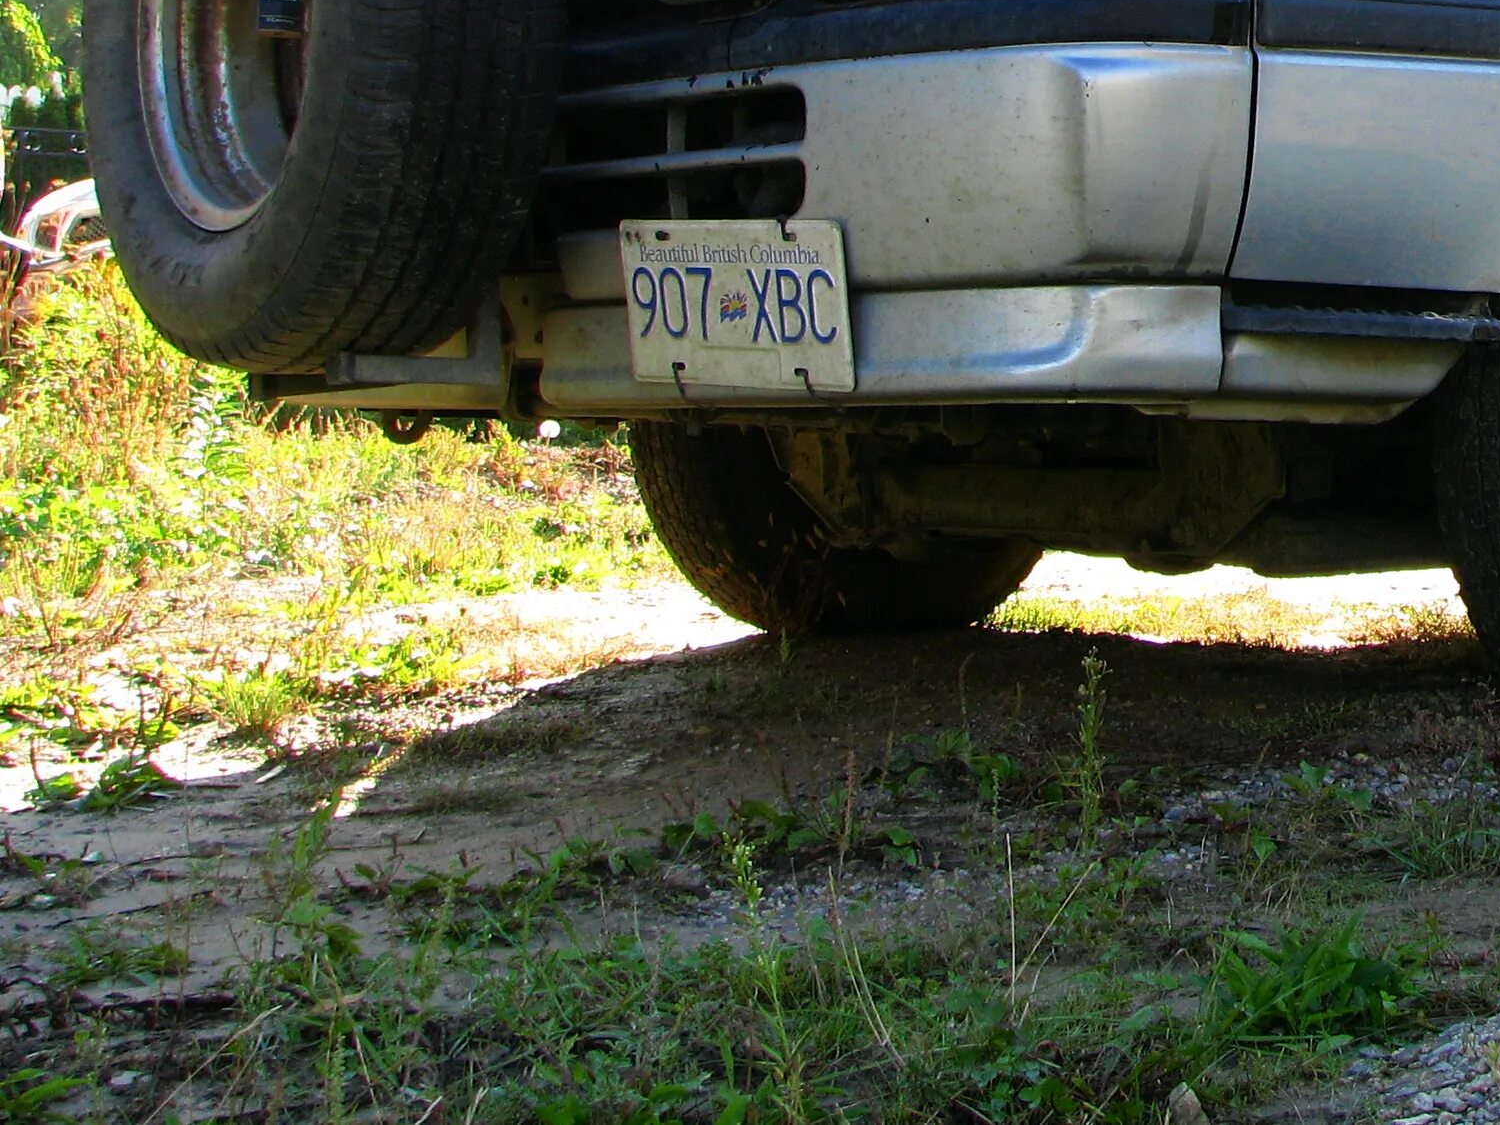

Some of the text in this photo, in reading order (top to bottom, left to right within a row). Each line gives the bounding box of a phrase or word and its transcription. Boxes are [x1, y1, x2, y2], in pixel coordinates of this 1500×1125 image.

[639, 244, 820, 265] Beautiful British Columbia
[632, 266, 837, 344] 907 XBC
